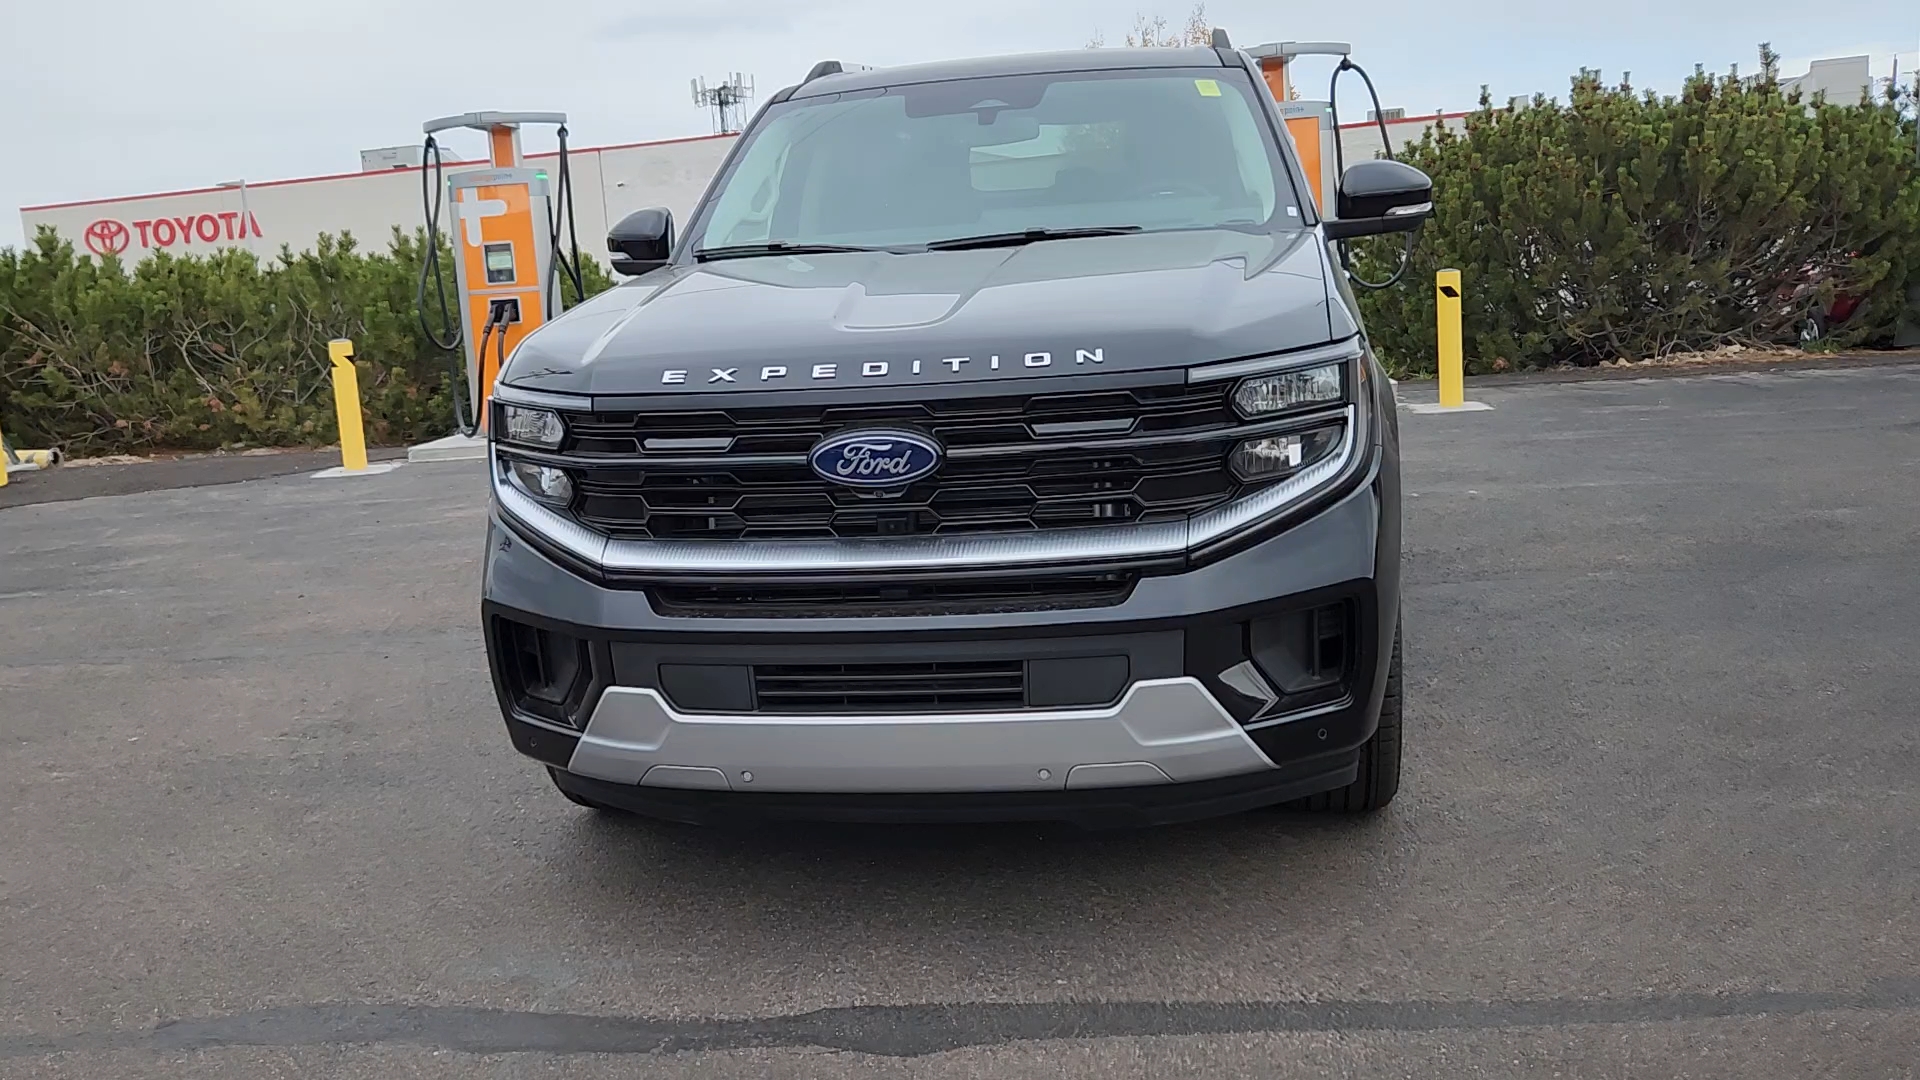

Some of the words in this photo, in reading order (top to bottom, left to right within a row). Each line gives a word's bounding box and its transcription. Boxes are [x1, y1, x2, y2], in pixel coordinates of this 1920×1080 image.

[132, 210, 263, 249] TOYOTA
[661, 348, 1105, 384] EXPEDITION
[836, 443, 912, 476] Ford
